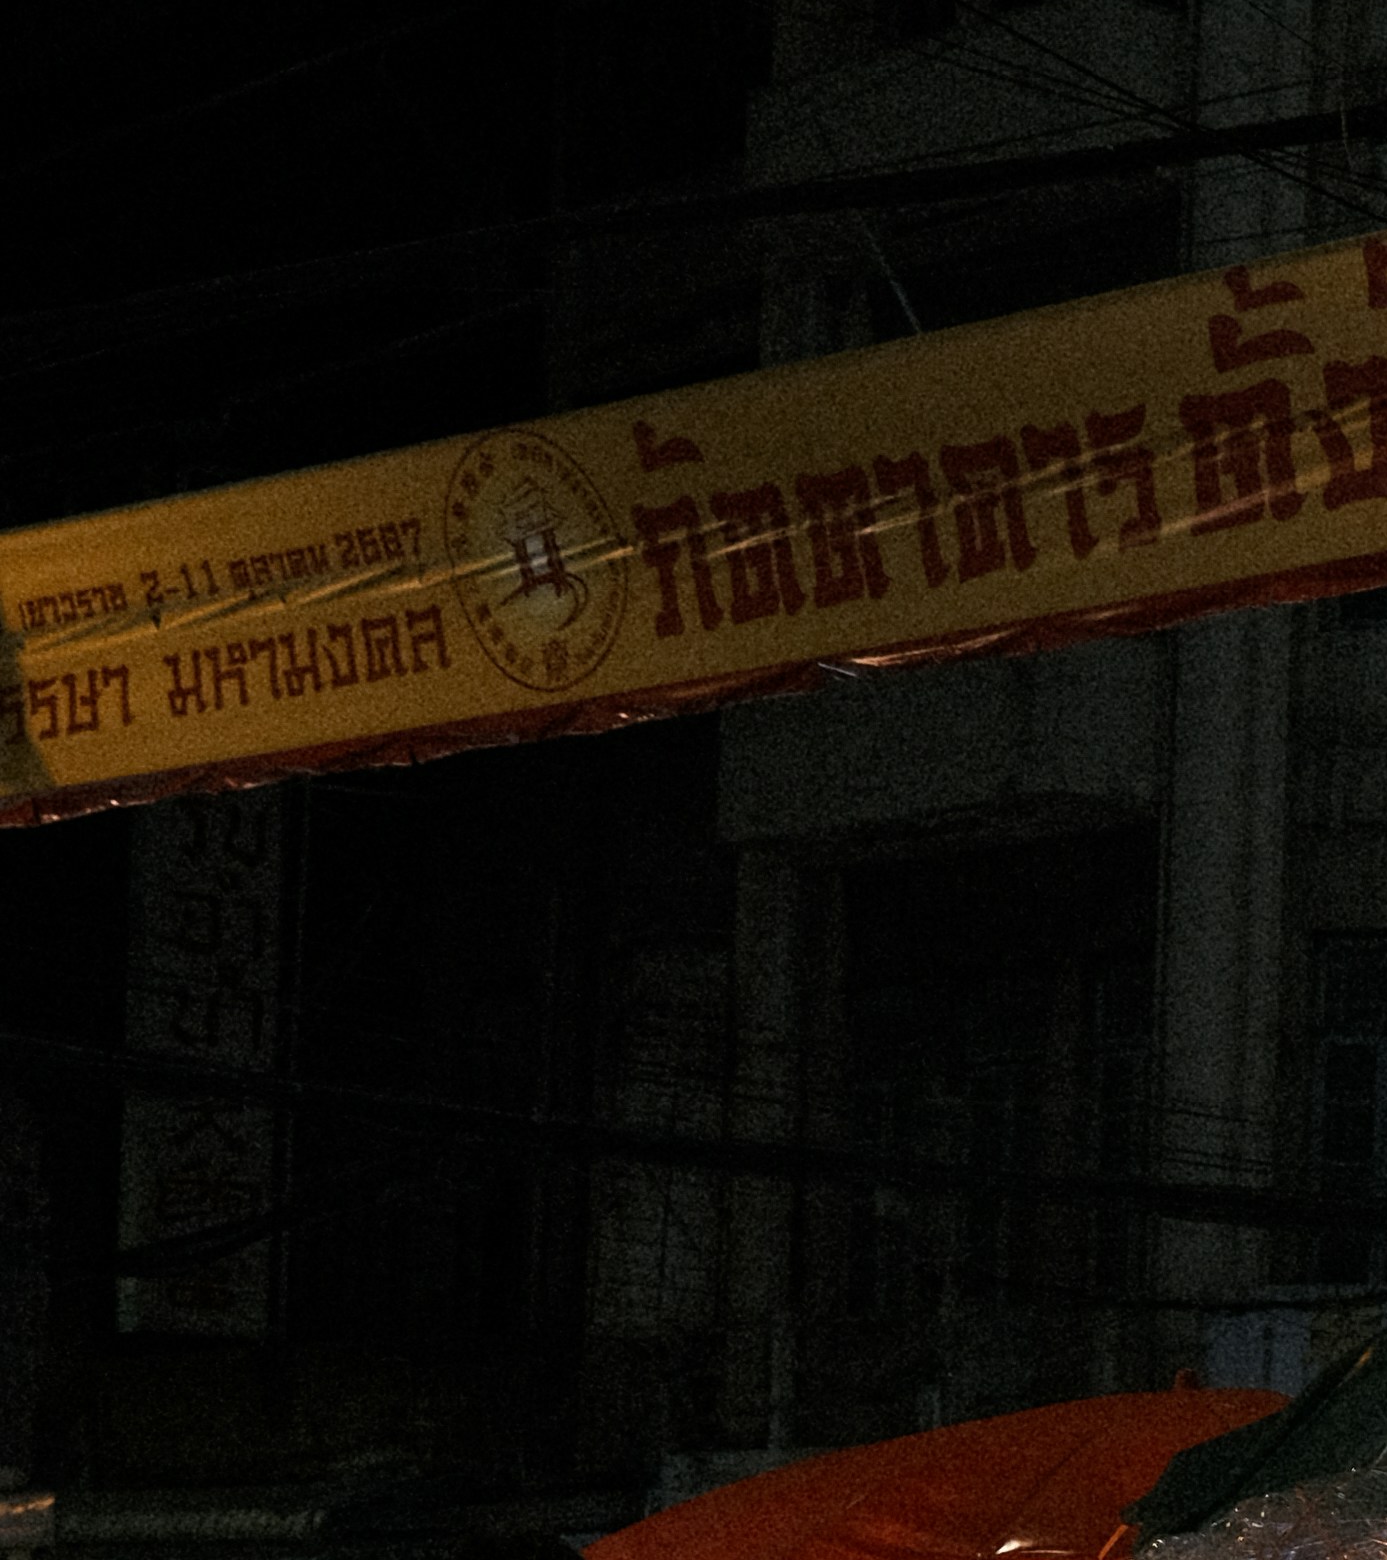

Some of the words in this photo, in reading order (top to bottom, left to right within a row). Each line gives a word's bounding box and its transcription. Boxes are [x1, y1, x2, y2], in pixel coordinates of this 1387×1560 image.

[141, 562, 219, 608] 2-11
[334, 518, 424, 575] 2567
[164, 604, 451, 717] มหามงคล
